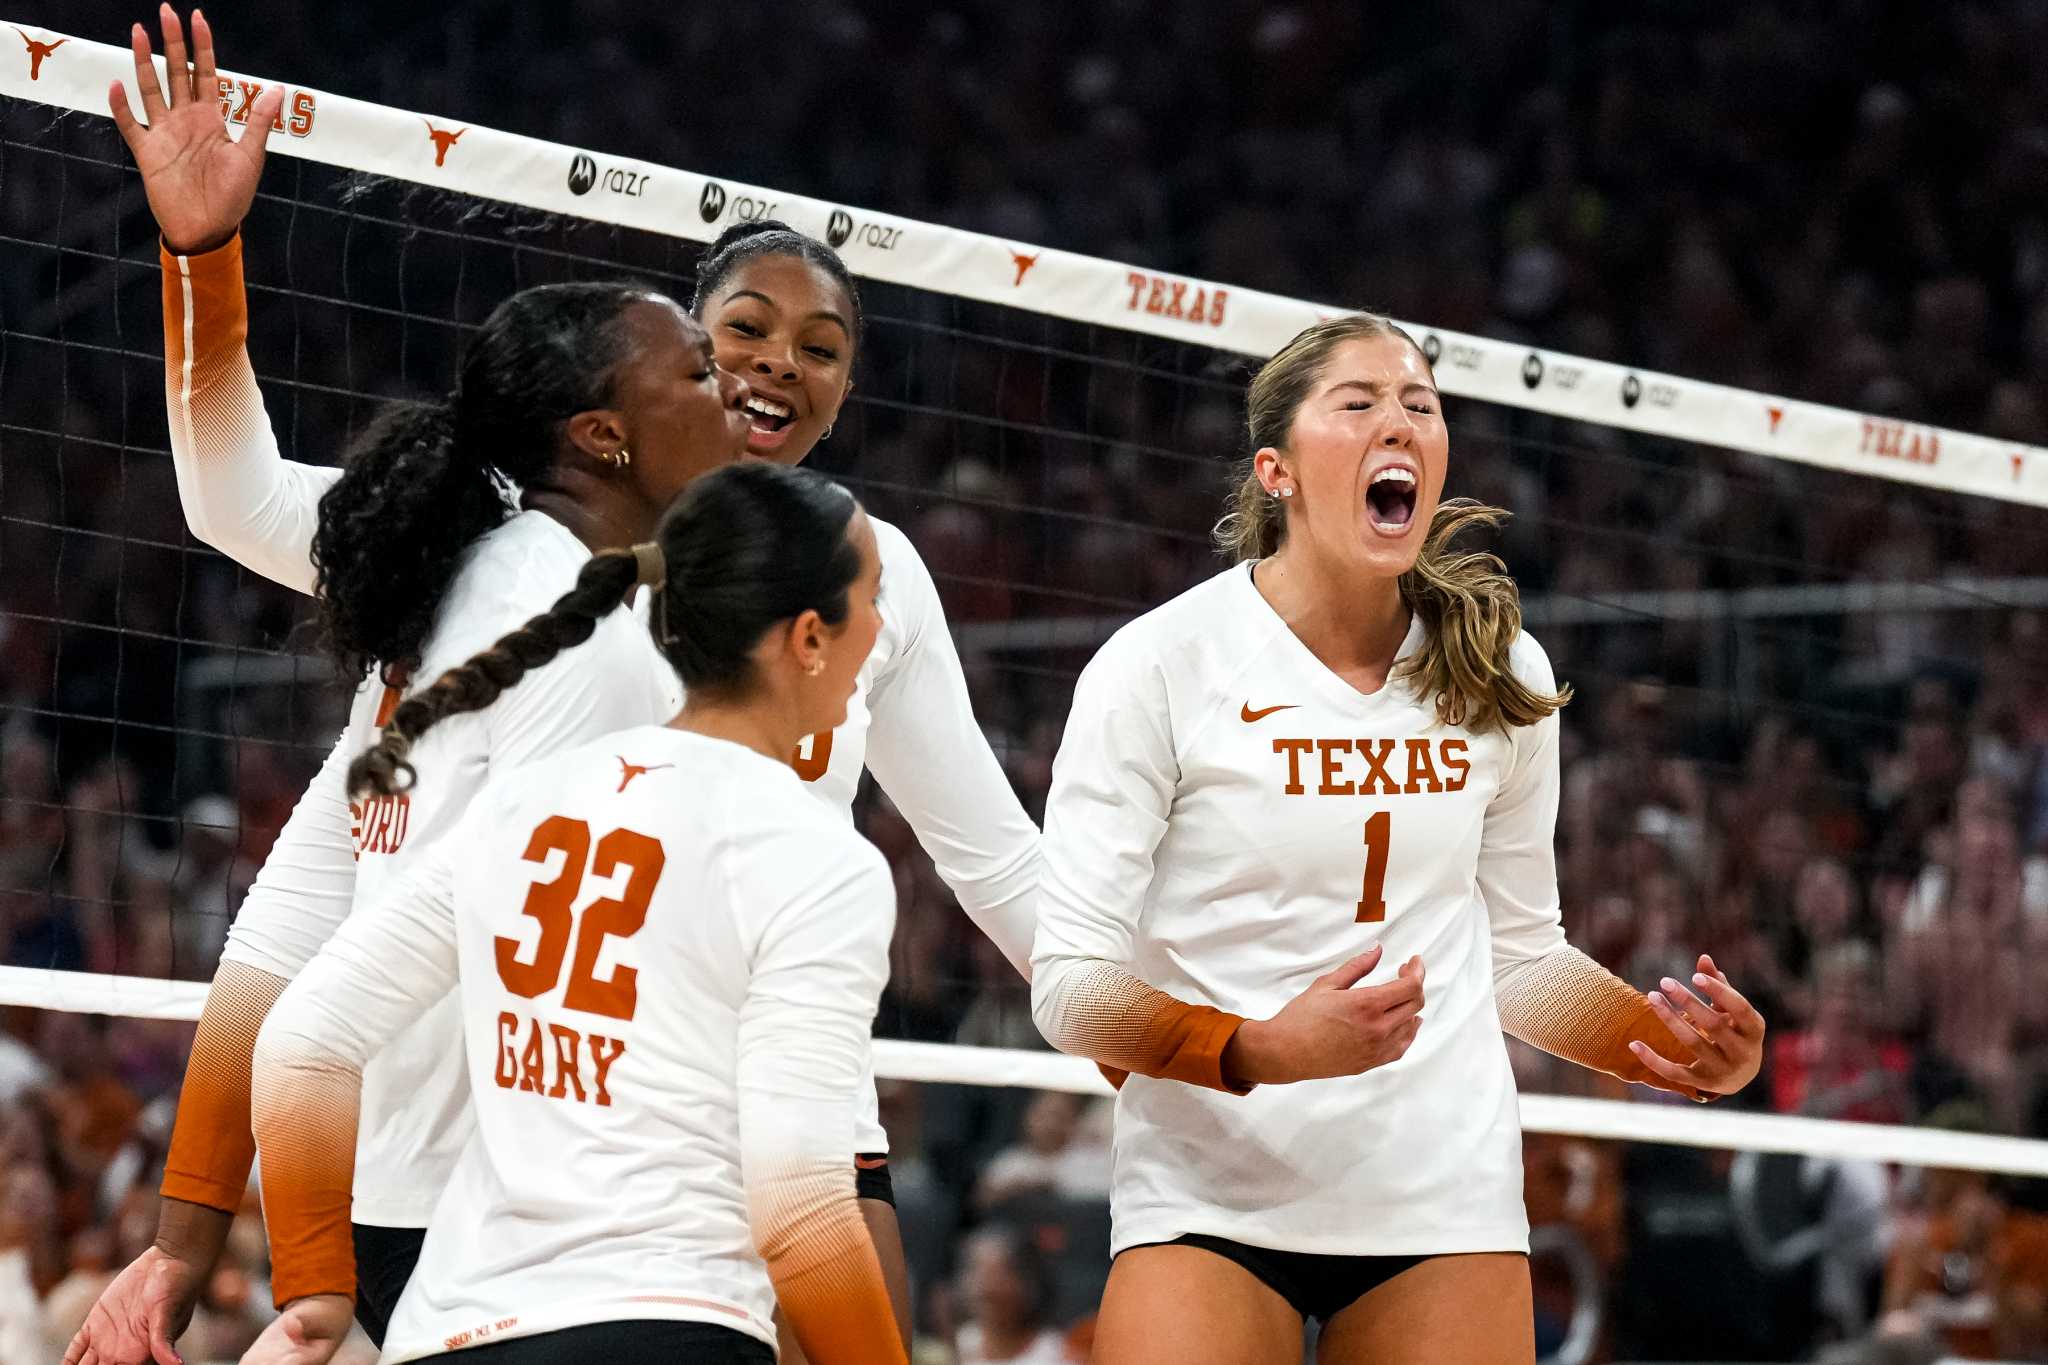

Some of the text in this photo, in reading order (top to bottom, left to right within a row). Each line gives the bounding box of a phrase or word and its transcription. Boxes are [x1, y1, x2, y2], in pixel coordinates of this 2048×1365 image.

[188, 68, 316, 138] EXS
[601, 166, 650, 198] razr
[856, 222, 902, 250] razr
[1127, 271, 1228, 328] TEXAS
[1272, 738, 1471, 796] TEXAS
[1354, 811, 1391, 923] 1
[493, 814, 666, 1021] 32
[494, 1010, 626, 1107] GARY
